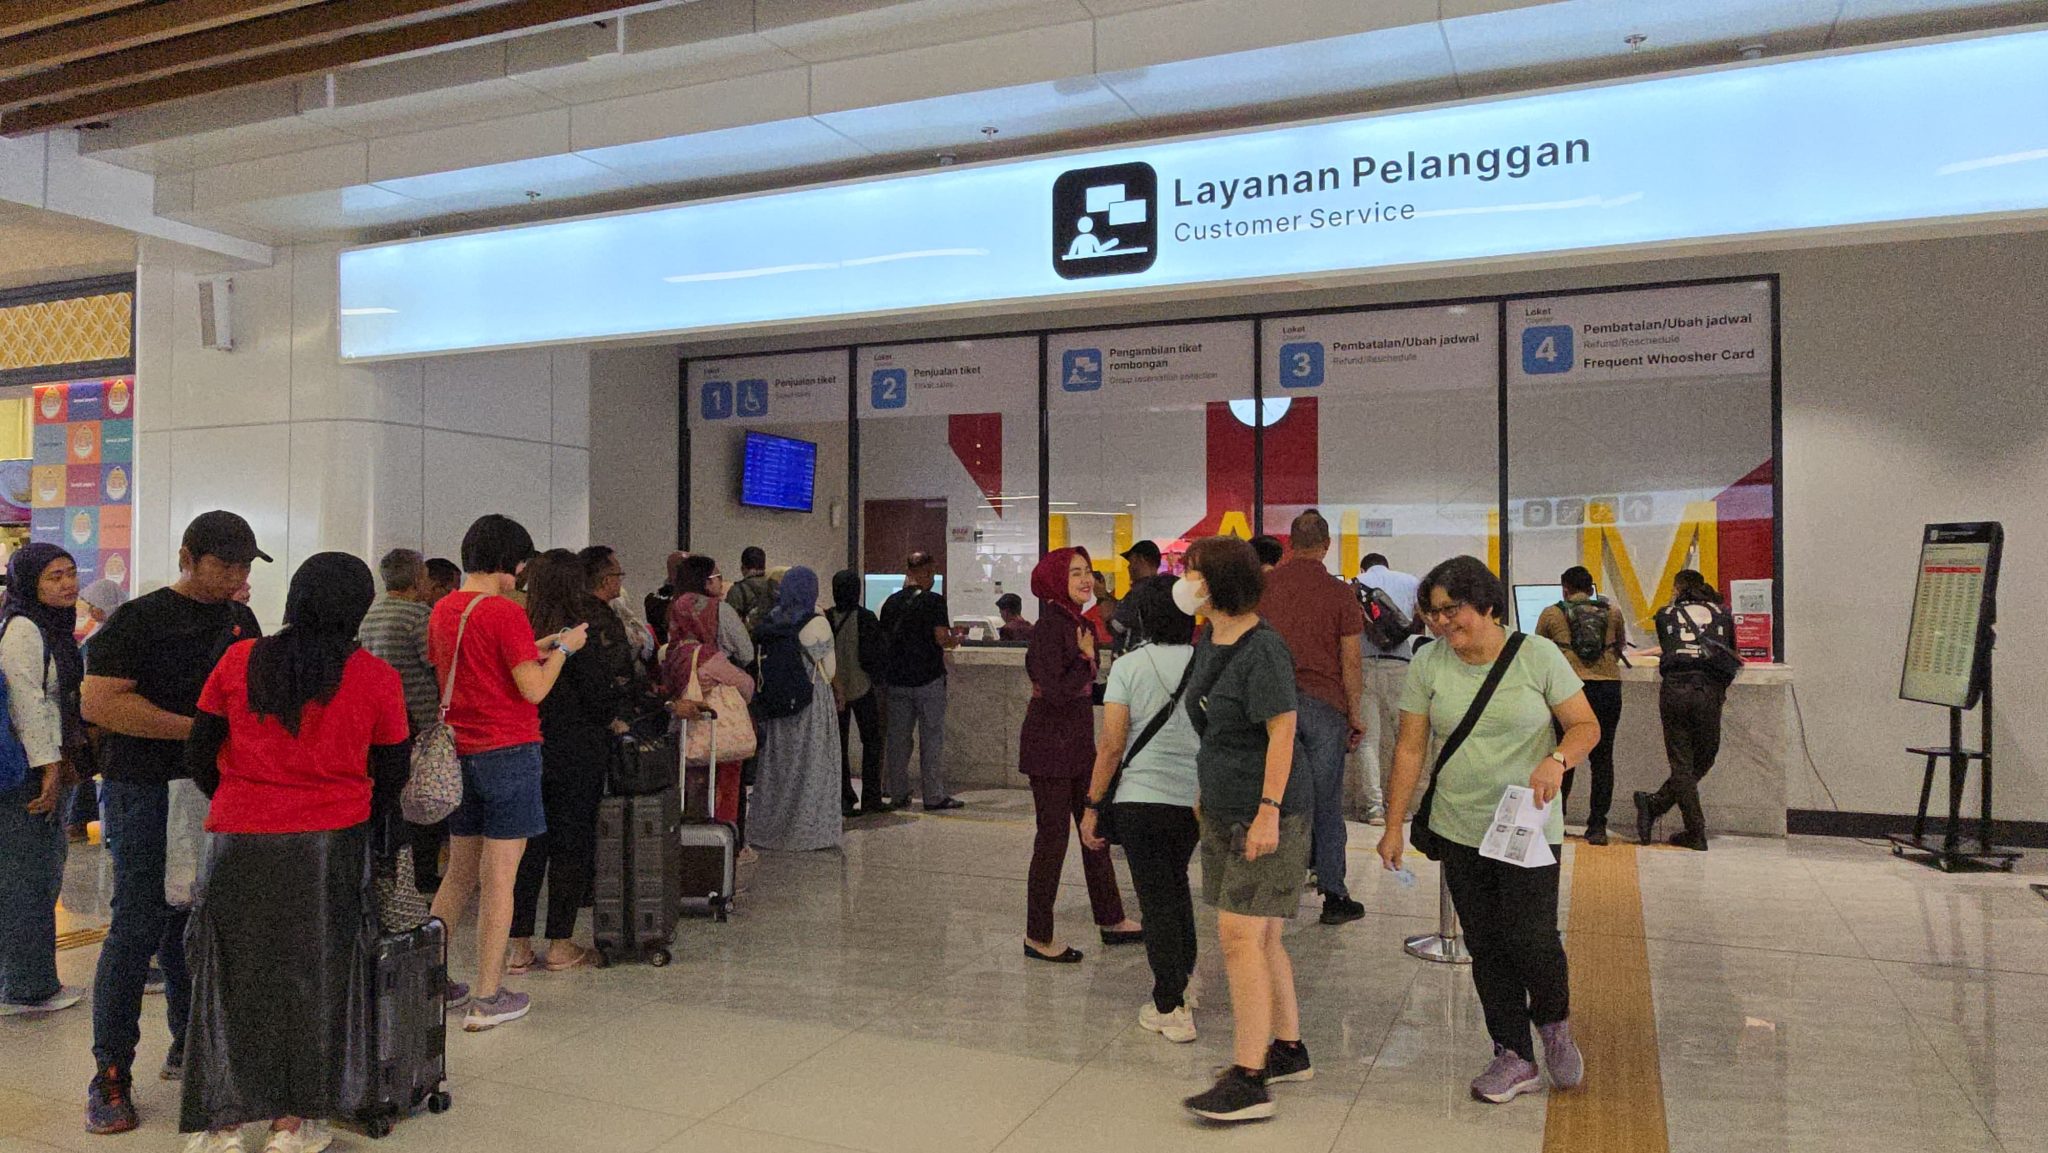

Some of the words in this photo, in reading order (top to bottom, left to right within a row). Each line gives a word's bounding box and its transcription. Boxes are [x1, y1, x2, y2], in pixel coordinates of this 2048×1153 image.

[1174, 160, 1341, 209] Layanan
[1353, 138, 1590, 186] Pelanggan
[1174, 213, 1302, 243] Customer
[1310, 202, 1416, 229] Service
[1583, 317, 1704, 335] Pembatalan/Ubah
[1705, 313, 1753, 328] jadwal
[1109, 346, 1176, 358] Pengambilan
[1178, 343, 1203, 354] tiket
[1333, 336, 1437, 352] Pembatalan/Ubah
[1439, 333, 1480, 348] jadwal
[1535, 335, 1558, 363] 4
[1110, 360, 1168, 370] rombongan
[1292, 351, 1311, 377] 3
[1583, 356, 1644, 371] Frequent
[1647, 351, 1717, 366] Whoosher
[1721, 348, 1755, 361] Card
[913, 367, 958, 379] Penjualan
[960, 365, 981, 375] tiket
[882, 376, 898, 400] 2
[711, 390, 722, 411] 1
